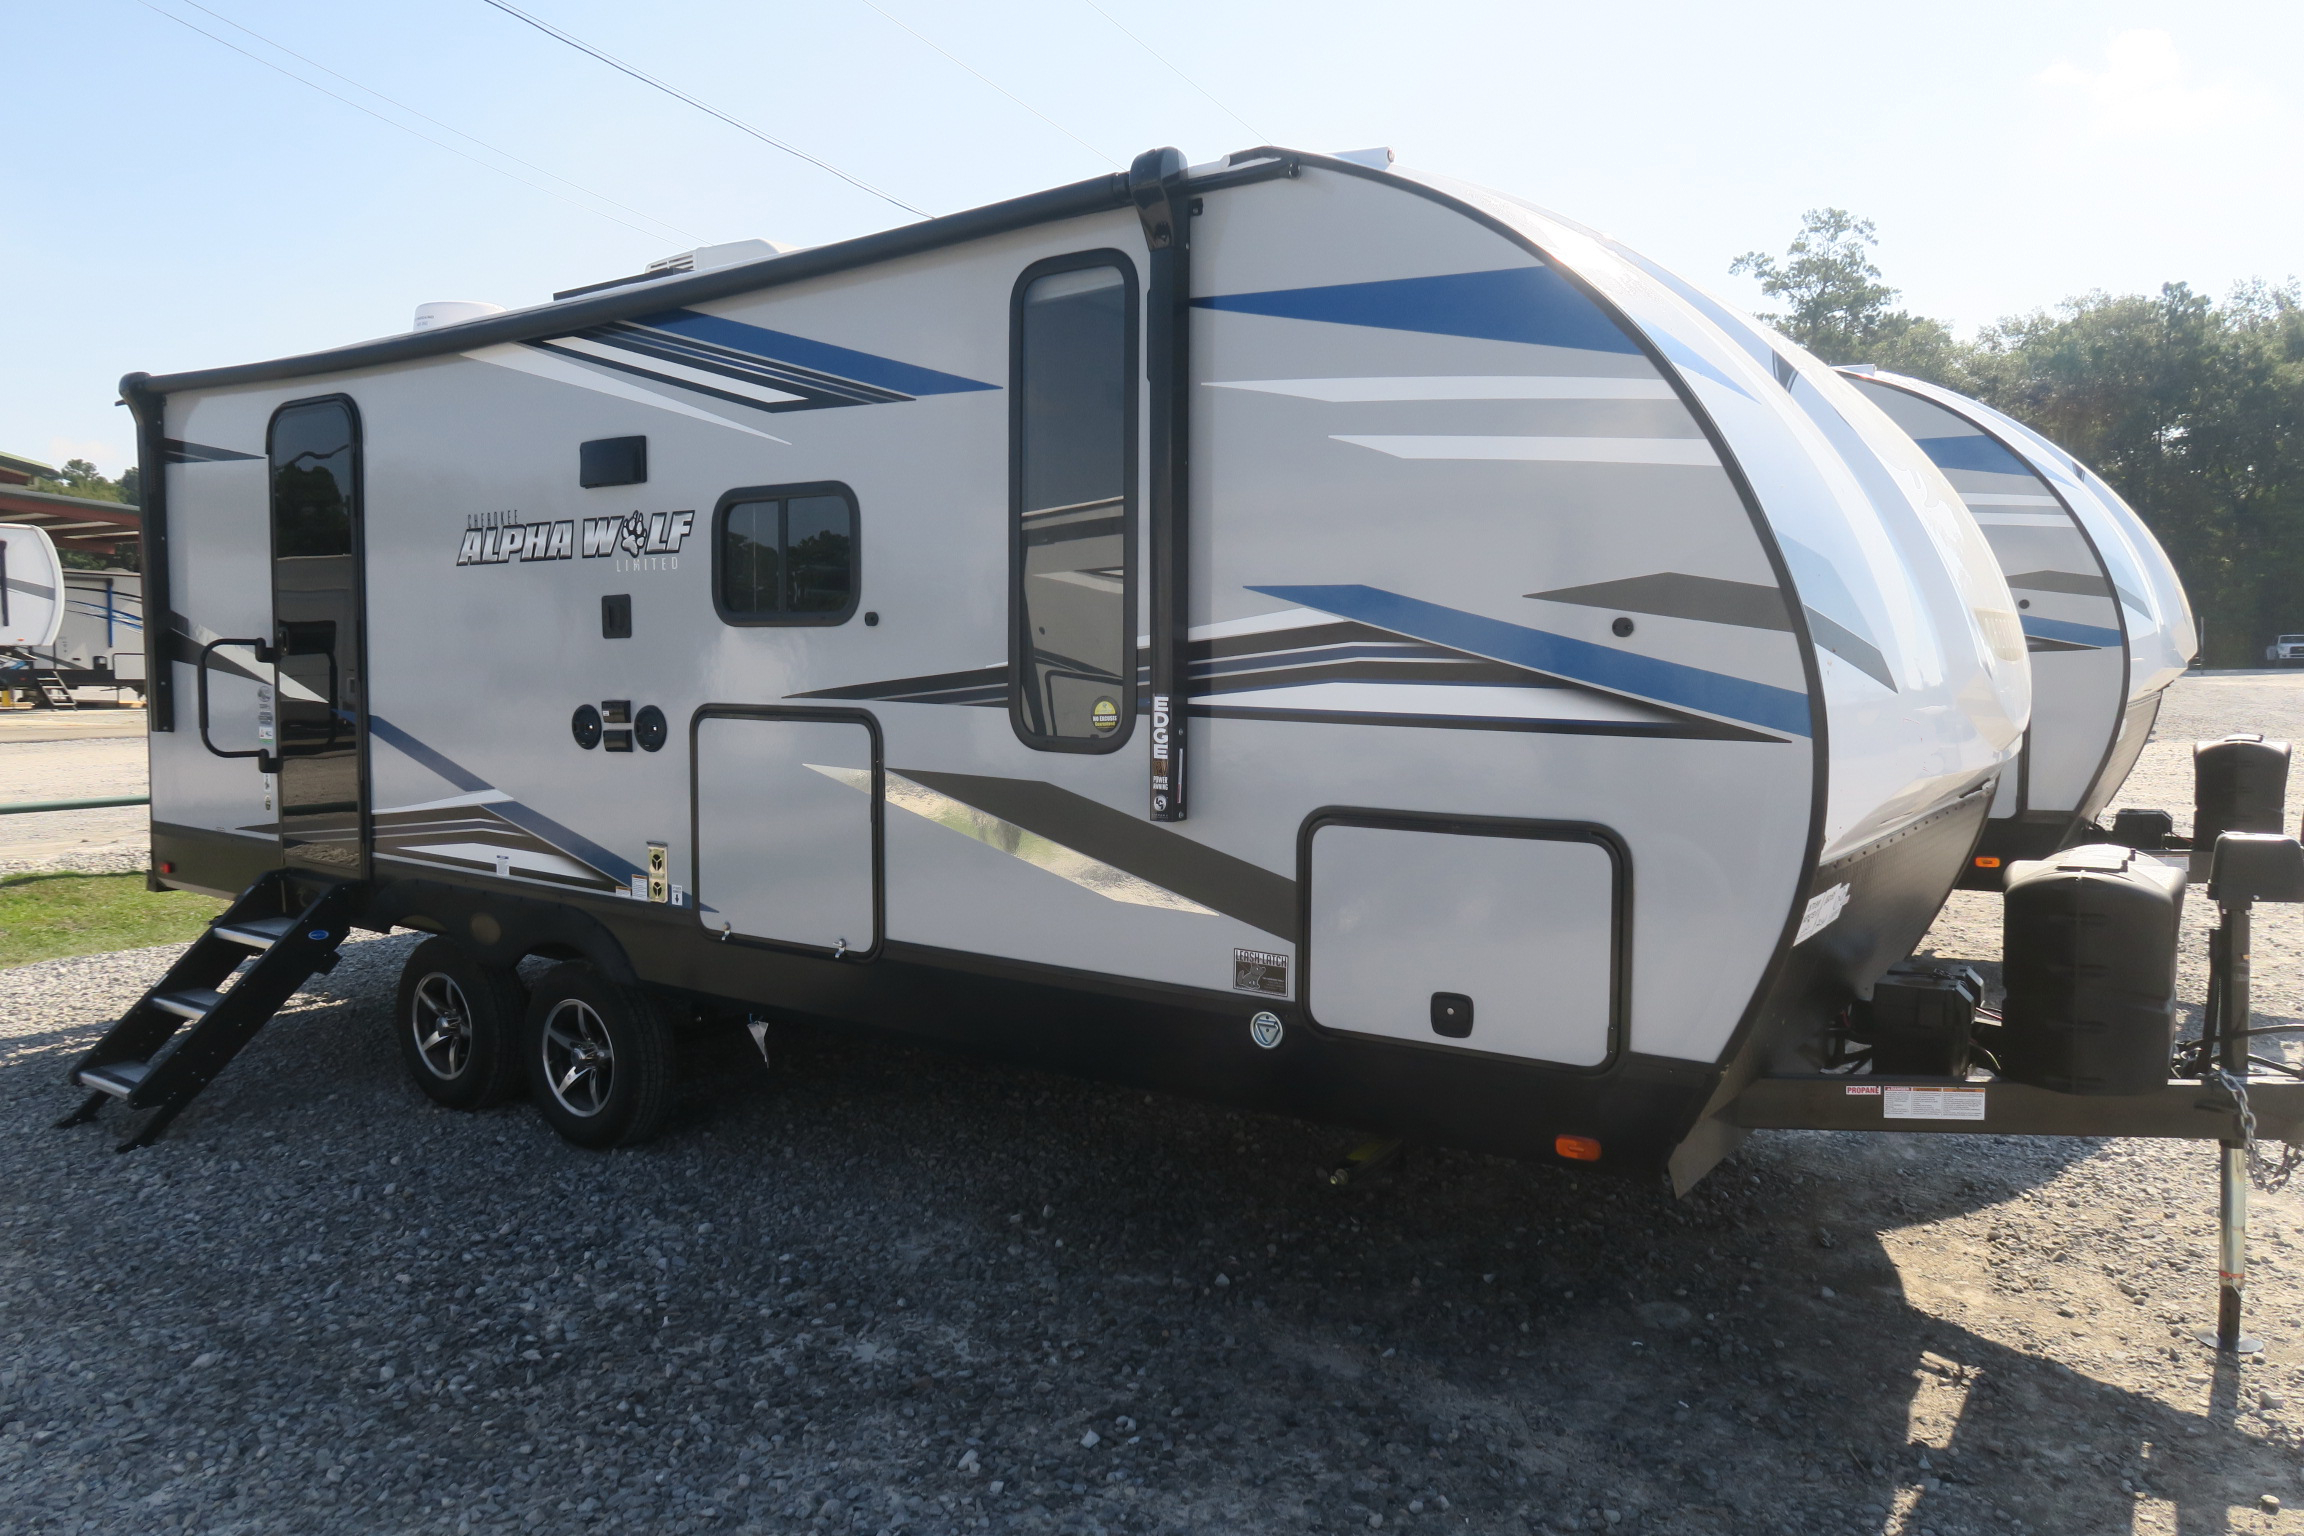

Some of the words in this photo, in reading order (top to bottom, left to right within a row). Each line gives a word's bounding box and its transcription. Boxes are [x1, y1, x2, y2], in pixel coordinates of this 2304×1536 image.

[456, 519, 575, 566] ALPHA
[616, 556, 678, 573] LIMITED
[1153, 696, 1169, 759] EDGE
